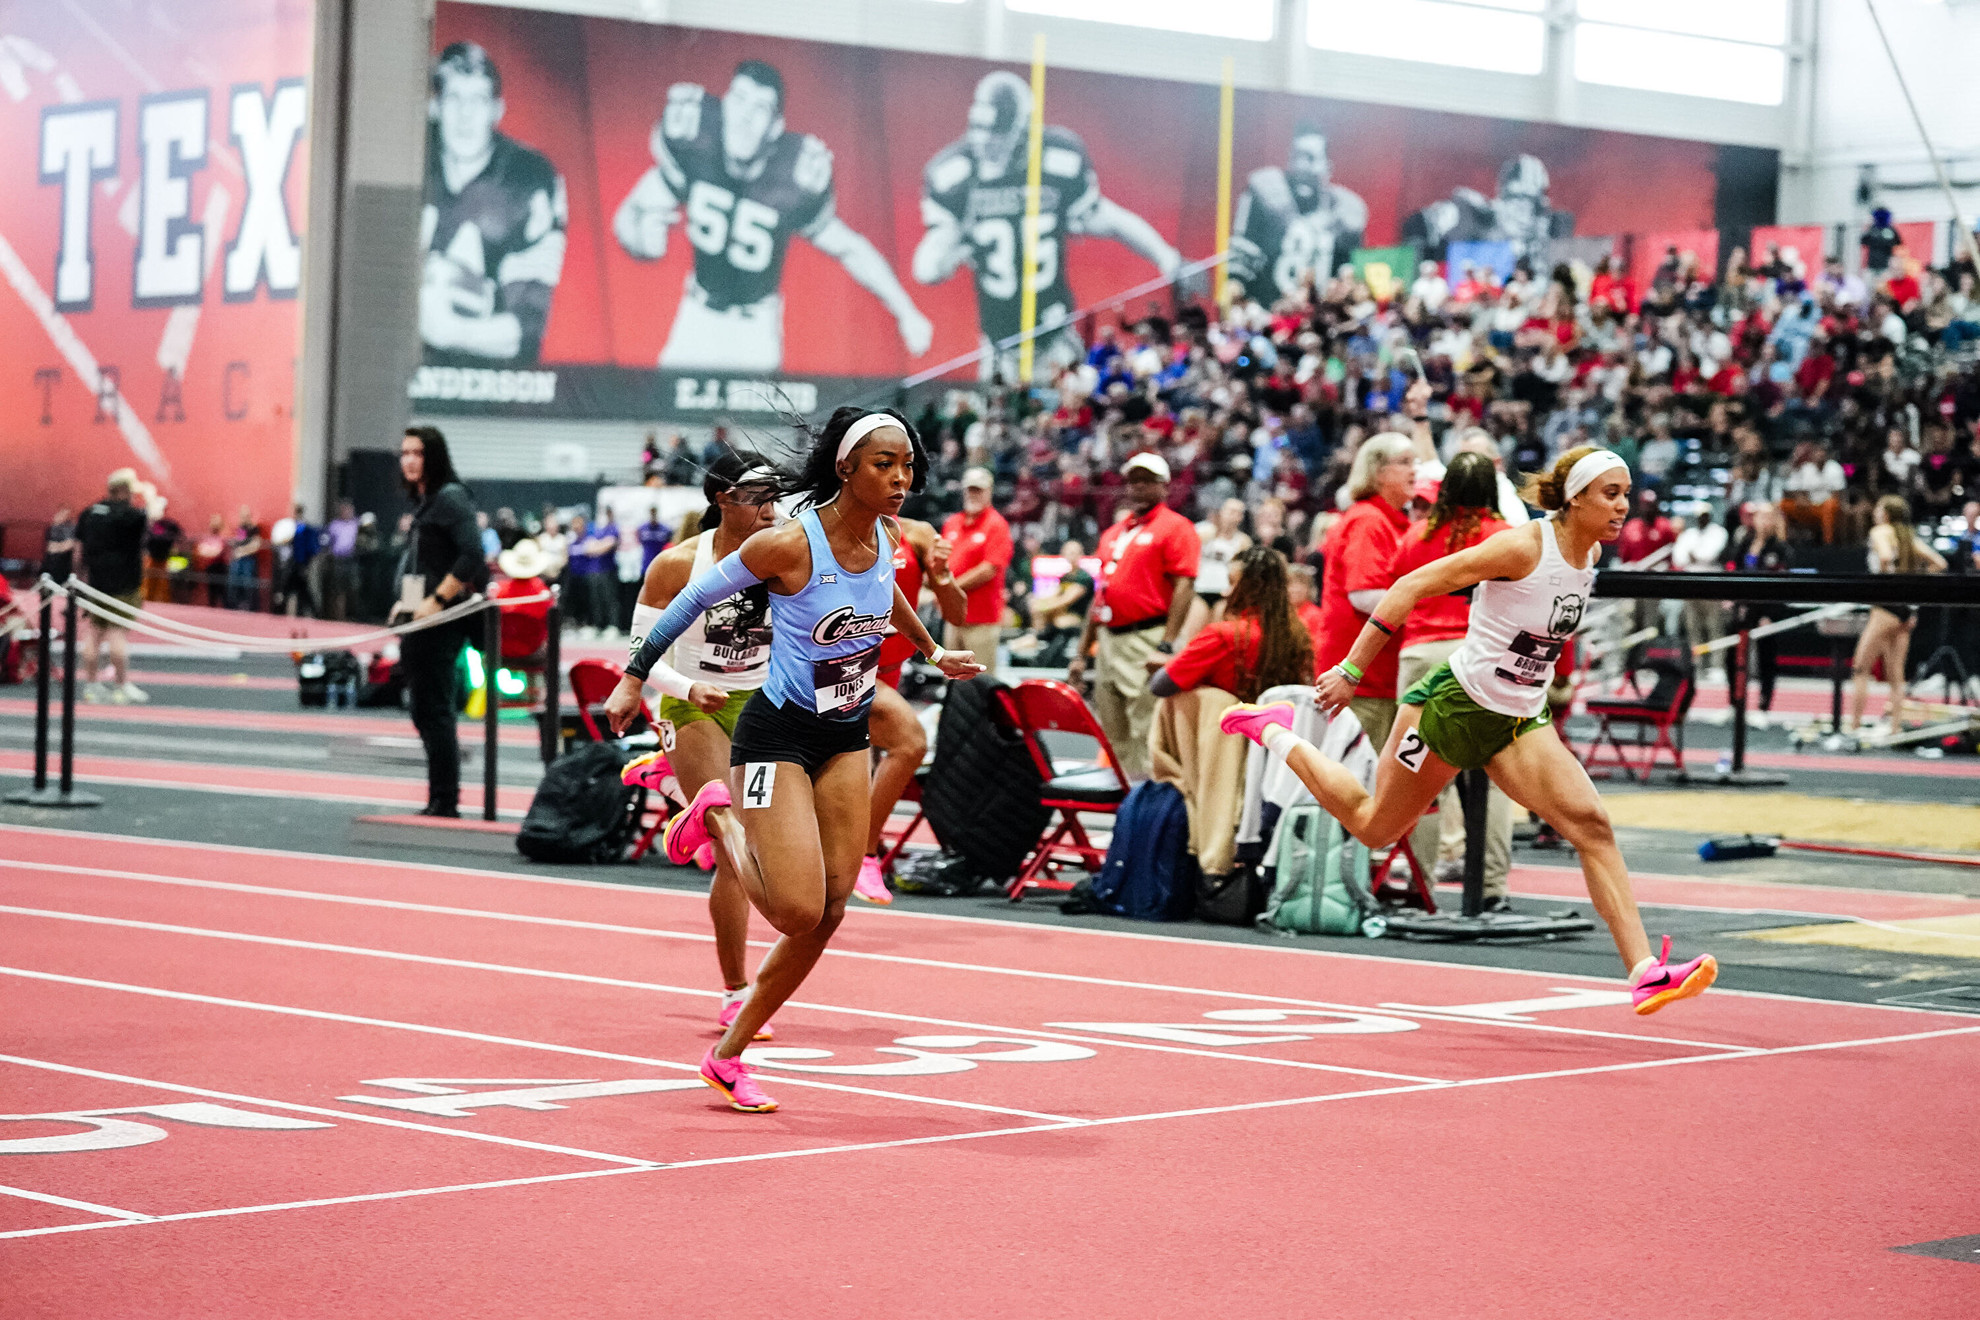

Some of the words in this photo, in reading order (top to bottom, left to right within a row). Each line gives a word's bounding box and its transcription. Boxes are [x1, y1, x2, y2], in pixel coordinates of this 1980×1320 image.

[39, 77, 308, 314] TEX
[688, 180, 779, 272] 55
[34, 360, 299, 427] TRAC
[1514, 656, 1549, 673] BROWN
[834, 675, 865, 698] JONES
[1398, 734, 1424, 767] 2
[747, 765, 766, 805] 4
[334, 1078, 708, 1117] 4
